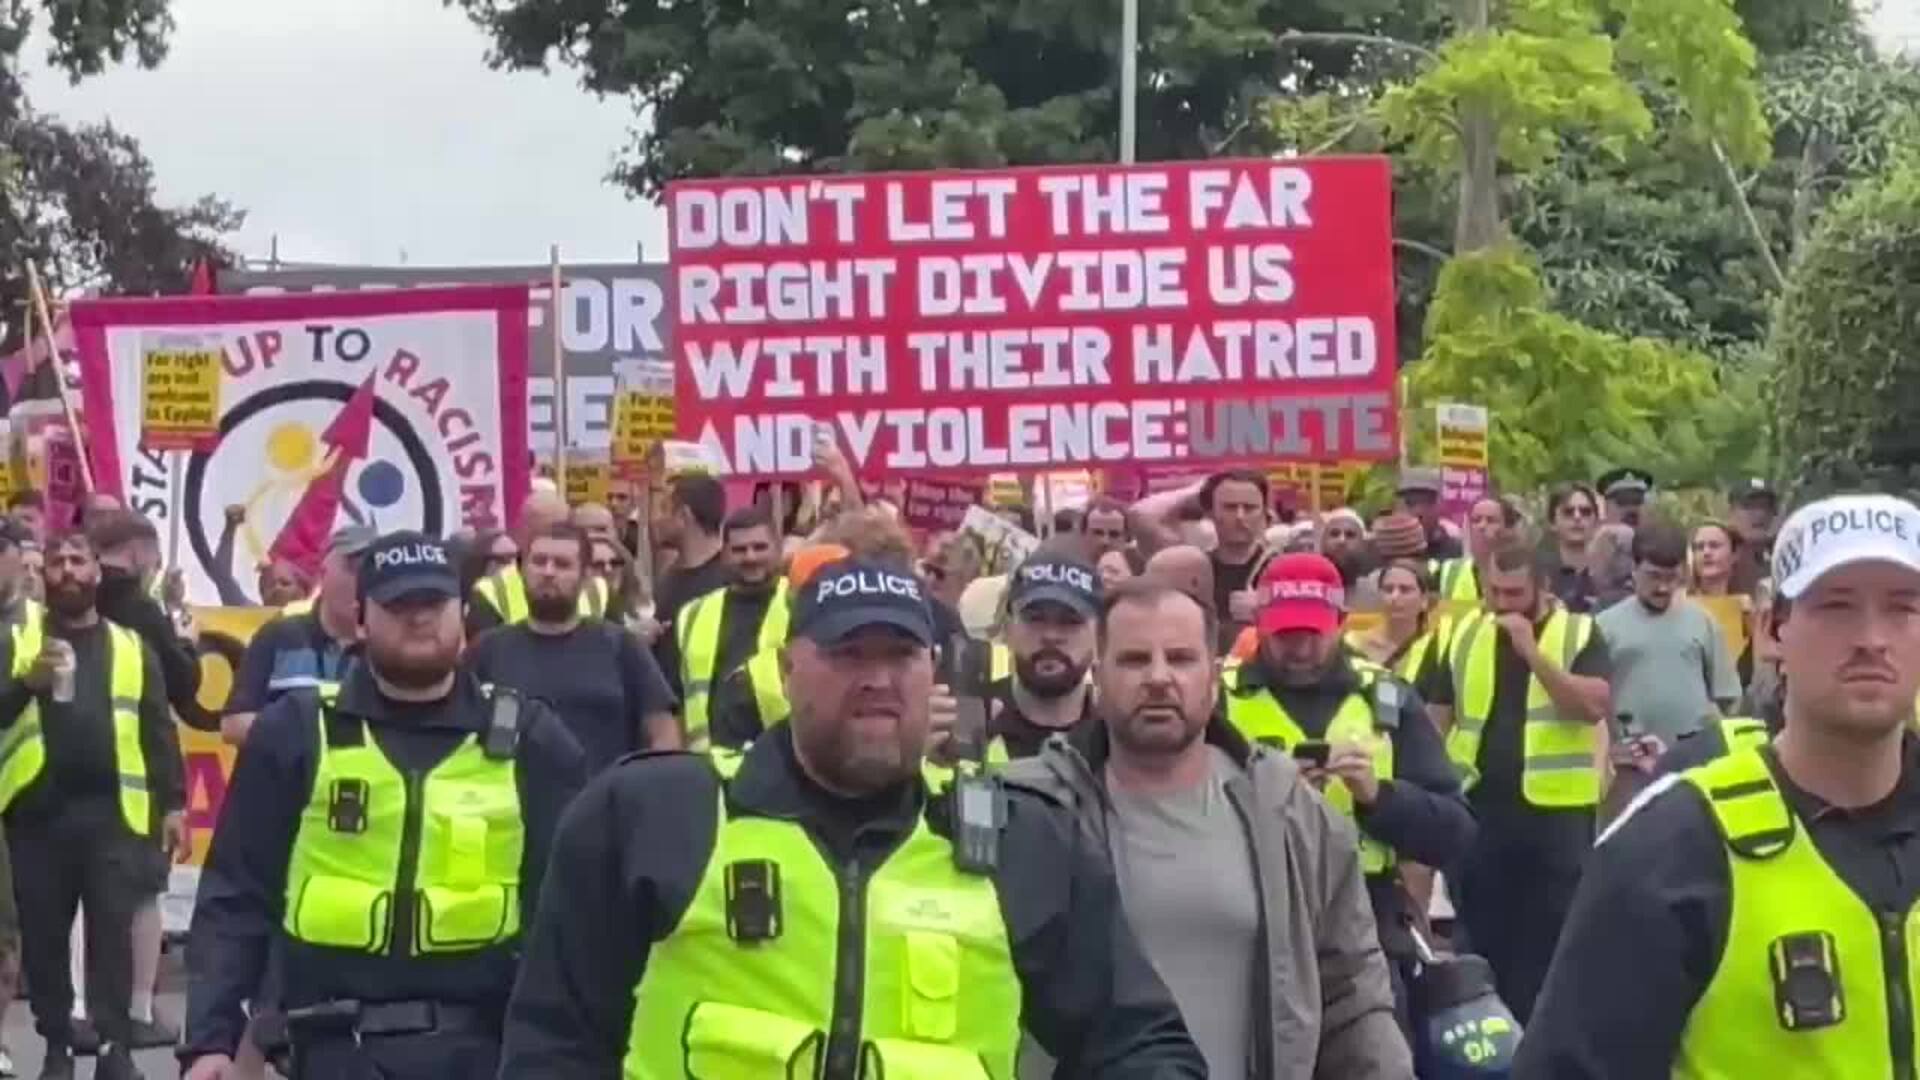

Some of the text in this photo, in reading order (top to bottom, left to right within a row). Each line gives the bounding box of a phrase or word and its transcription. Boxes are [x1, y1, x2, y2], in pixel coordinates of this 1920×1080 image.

[676, 167, 1313, 248] DON'T LET THE FAR
[679, 244, 1294, 324] RIGHT DIVIDE US
[683, 316, 1377, 399] WITH THEIR HATRED
[221, 330, 283, 377] UP
[305, 325, 371, 362] TO
[384, 348, 499, 528] RACISM
[698, 413, 815, 474] AND
[374, 543, 448, 571] POLICE
[1811, 508, 1909, 544] POLICE
[816, 571, 921, 602] POLICE
